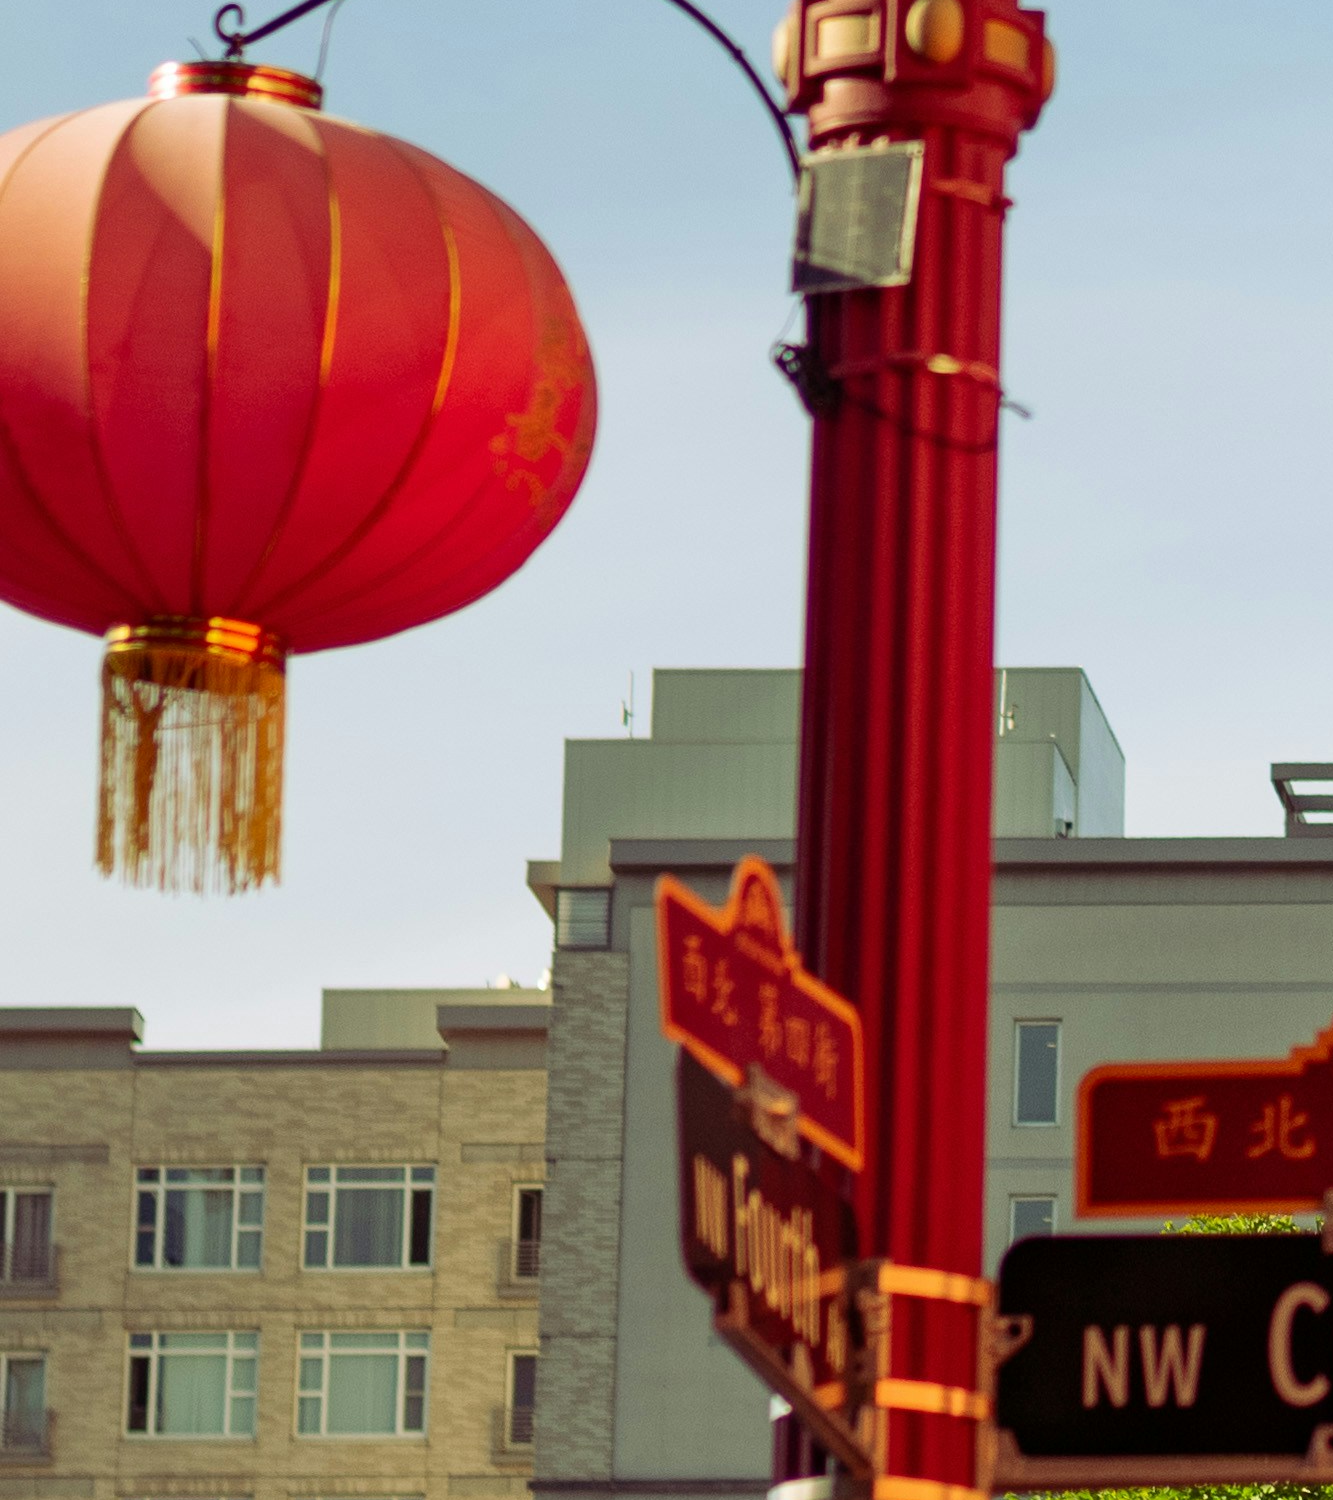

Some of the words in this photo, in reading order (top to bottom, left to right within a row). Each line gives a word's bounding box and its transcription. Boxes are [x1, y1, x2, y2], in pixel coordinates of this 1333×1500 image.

[1152, 1093, 1317, 1162] 西北
[693, 1153, 728, 1261] NW
[732, 1152, 822, 1347] Fourth
[1082, 1322, 1206, 1410] NW
